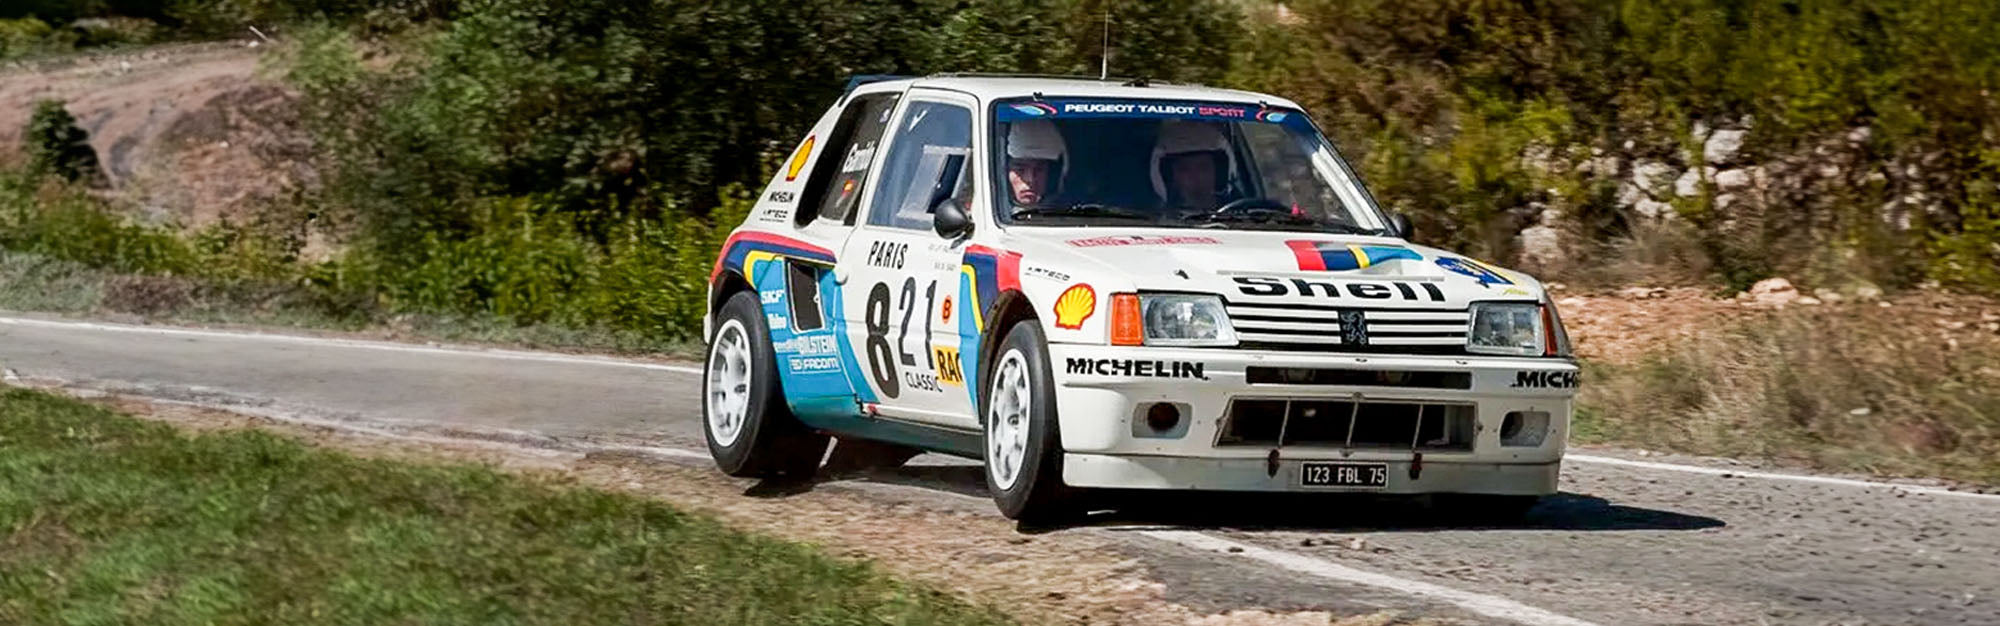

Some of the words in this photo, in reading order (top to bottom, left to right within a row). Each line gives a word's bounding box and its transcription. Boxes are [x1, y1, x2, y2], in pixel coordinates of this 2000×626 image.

[1065, 104, 1135, 113] PEUGEOT
[1138, 105, 1195, 114] TALBOT
[1199, 107, 1245, 117] SPORT
[867, 240, 908, 269] PARIS
[760, 289, 784, 304] SKF
[1233, 277, 1446, 303] Shell
[865, 277, 938, 399] 821
[1066, 357, 1204, 379] MICHELIN
[1307, 466, 1330, 483] 123
[1337, 466, 1362, 484] FBL
[1369, 467, 1385, 484] 75
